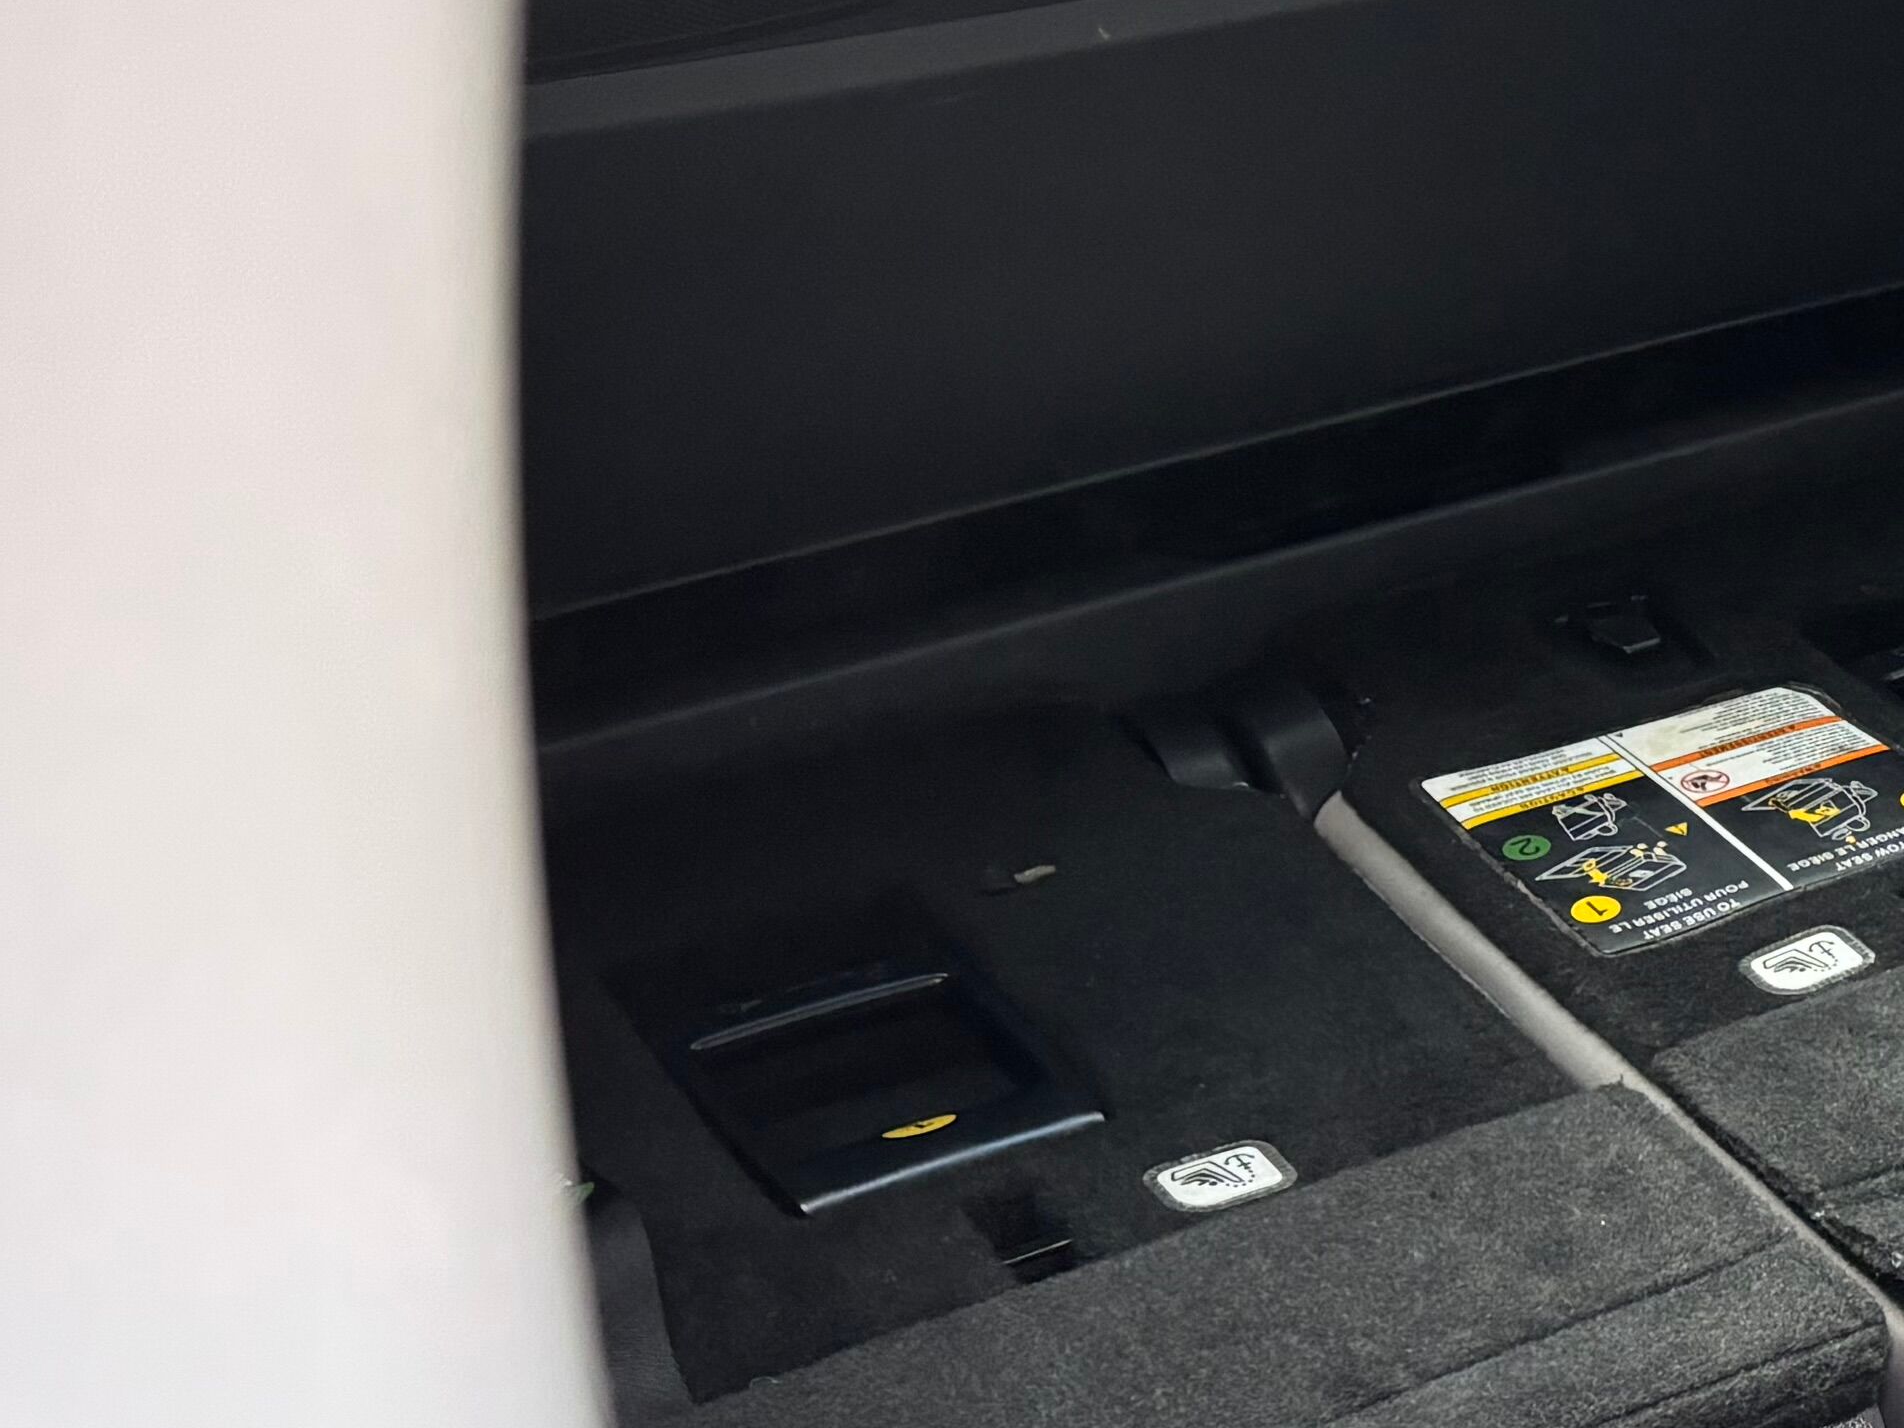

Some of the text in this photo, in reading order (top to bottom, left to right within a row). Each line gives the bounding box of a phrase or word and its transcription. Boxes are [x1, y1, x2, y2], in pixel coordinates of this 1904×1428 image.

[1509, 837, 1541, 857] 2
[1834, 844, 1856, 857] LE
[1834, 852, 1874, 872] SEAT
[1584, 900, 1608, 917] 1
[1607, 879, 1750, 934] POUR UTILISER LE
[1642, 898, 1741, 940] TO USE SEAT
